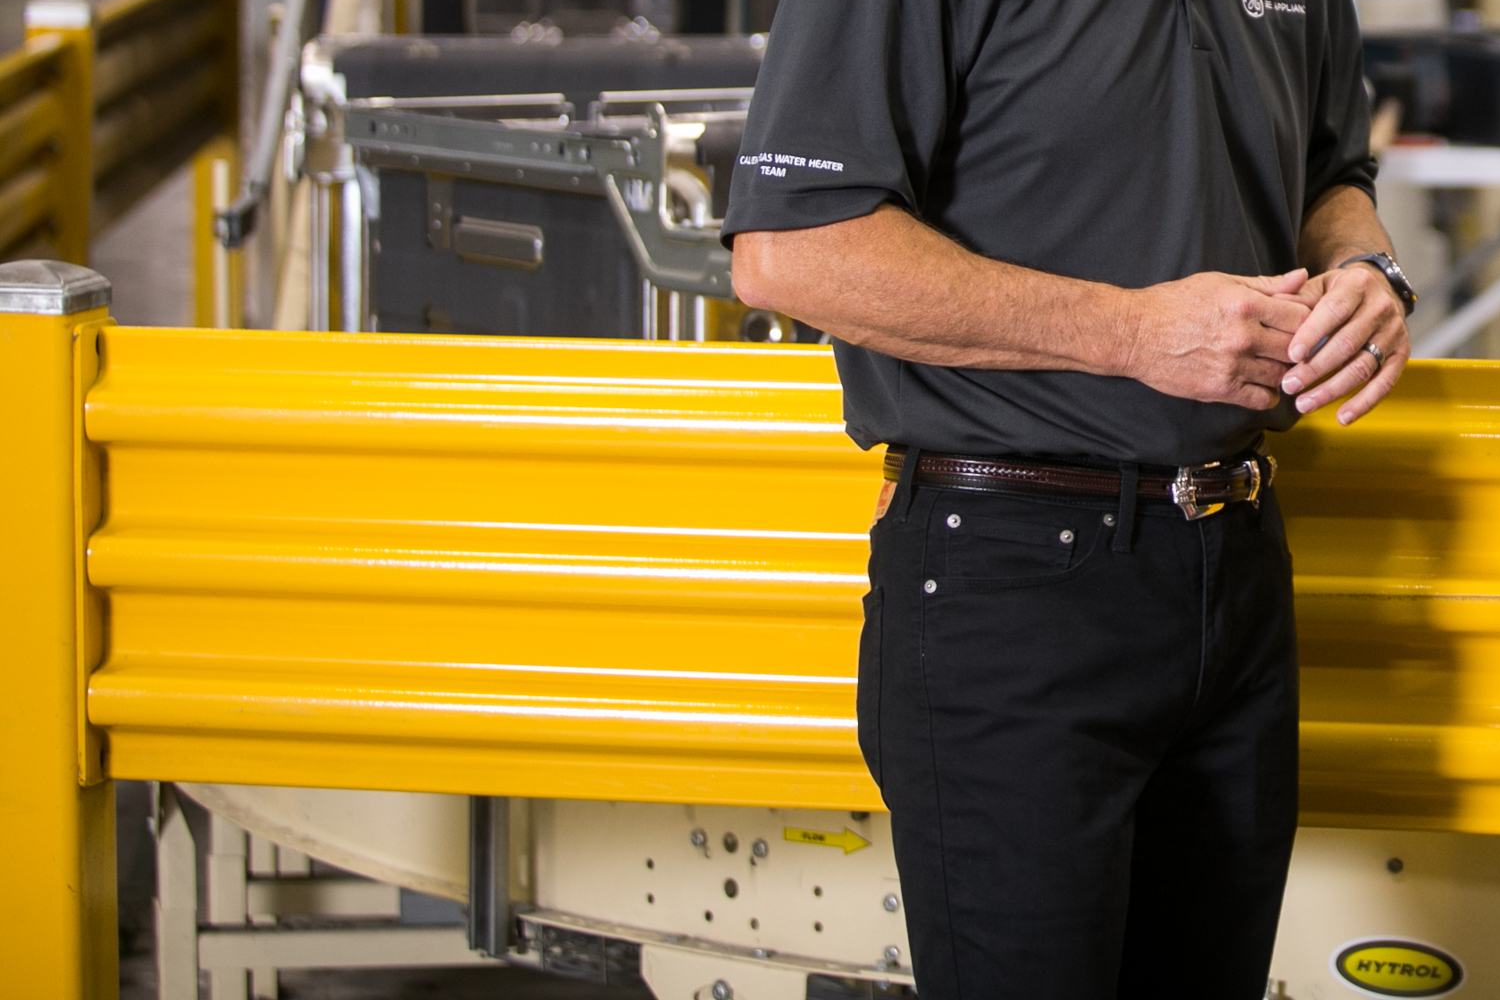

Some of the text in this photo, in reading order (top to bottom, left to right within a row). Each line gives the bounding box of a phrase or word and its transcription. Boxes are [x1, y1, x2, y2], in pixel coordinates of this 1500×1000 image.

[760, 166, 787, 178] TEAM
[774, 153, 806, 167] WATER
[808, 158, 844, 172] HEATER
[1356, 959, 1442, 979] HYTROL
